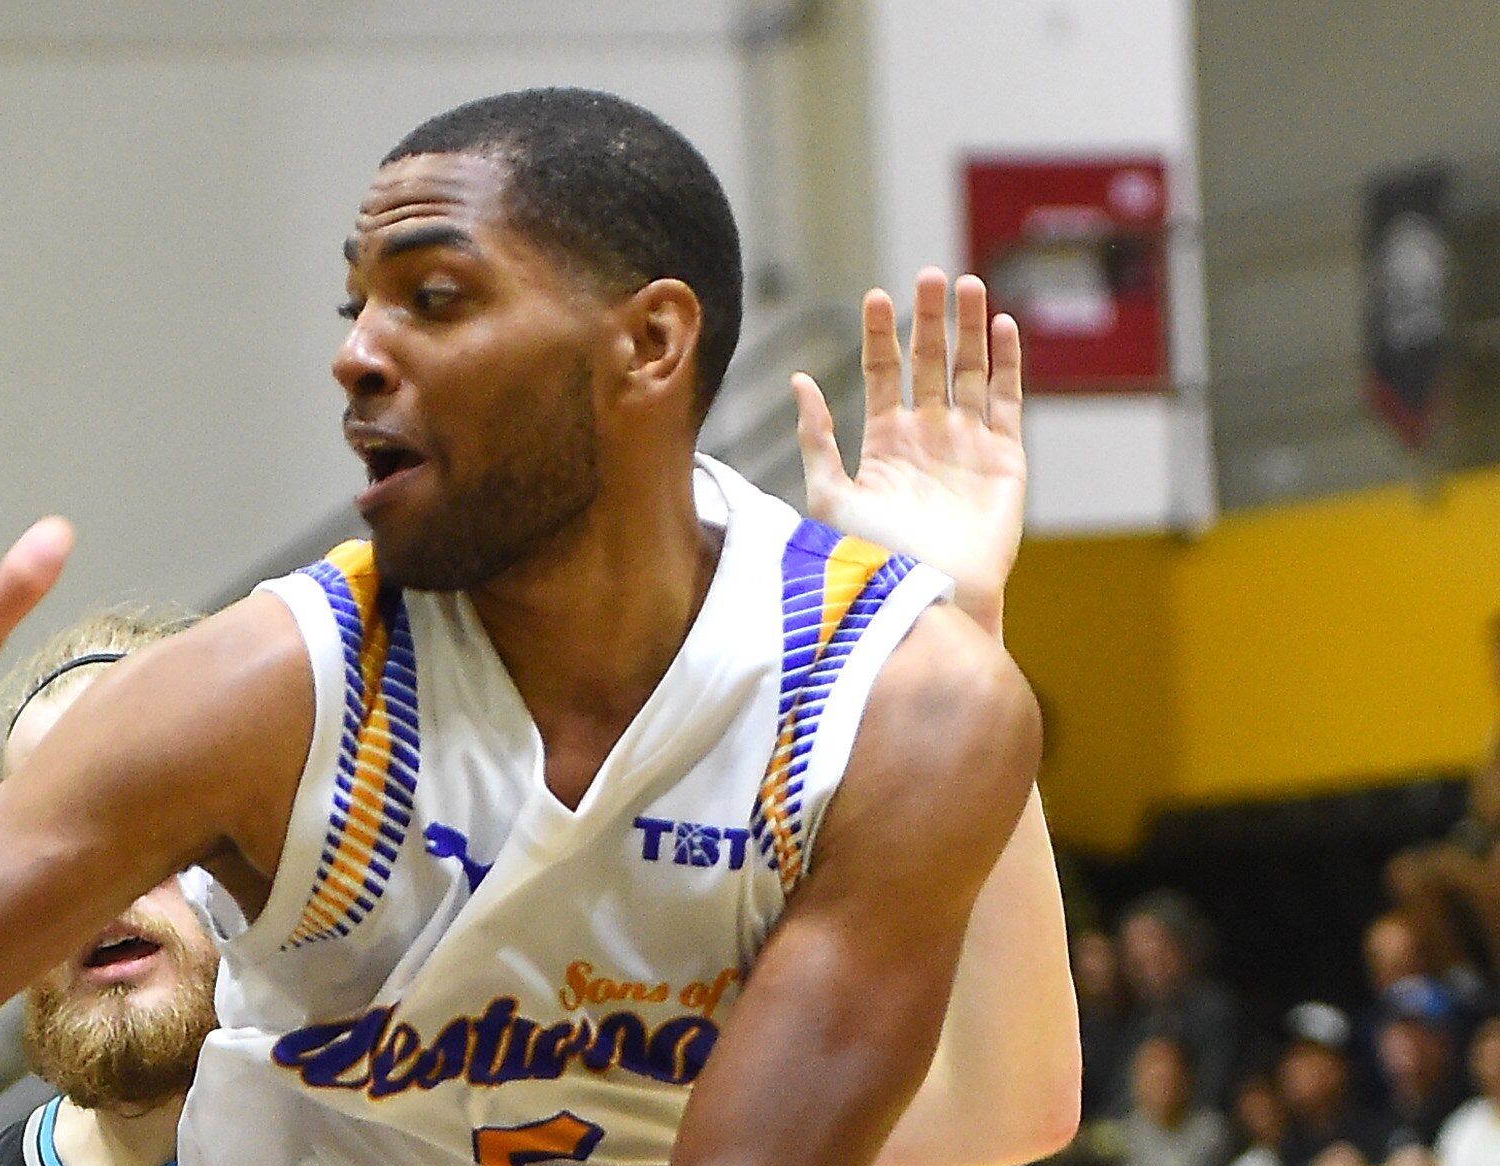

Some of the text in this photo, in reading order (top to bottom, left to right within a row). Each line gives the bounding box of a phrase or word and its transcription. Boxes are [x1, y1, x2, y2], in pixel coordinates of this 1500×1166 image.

[633, 815, 751, 871] TBT
[558, 960, 741, 1018] Sons of
